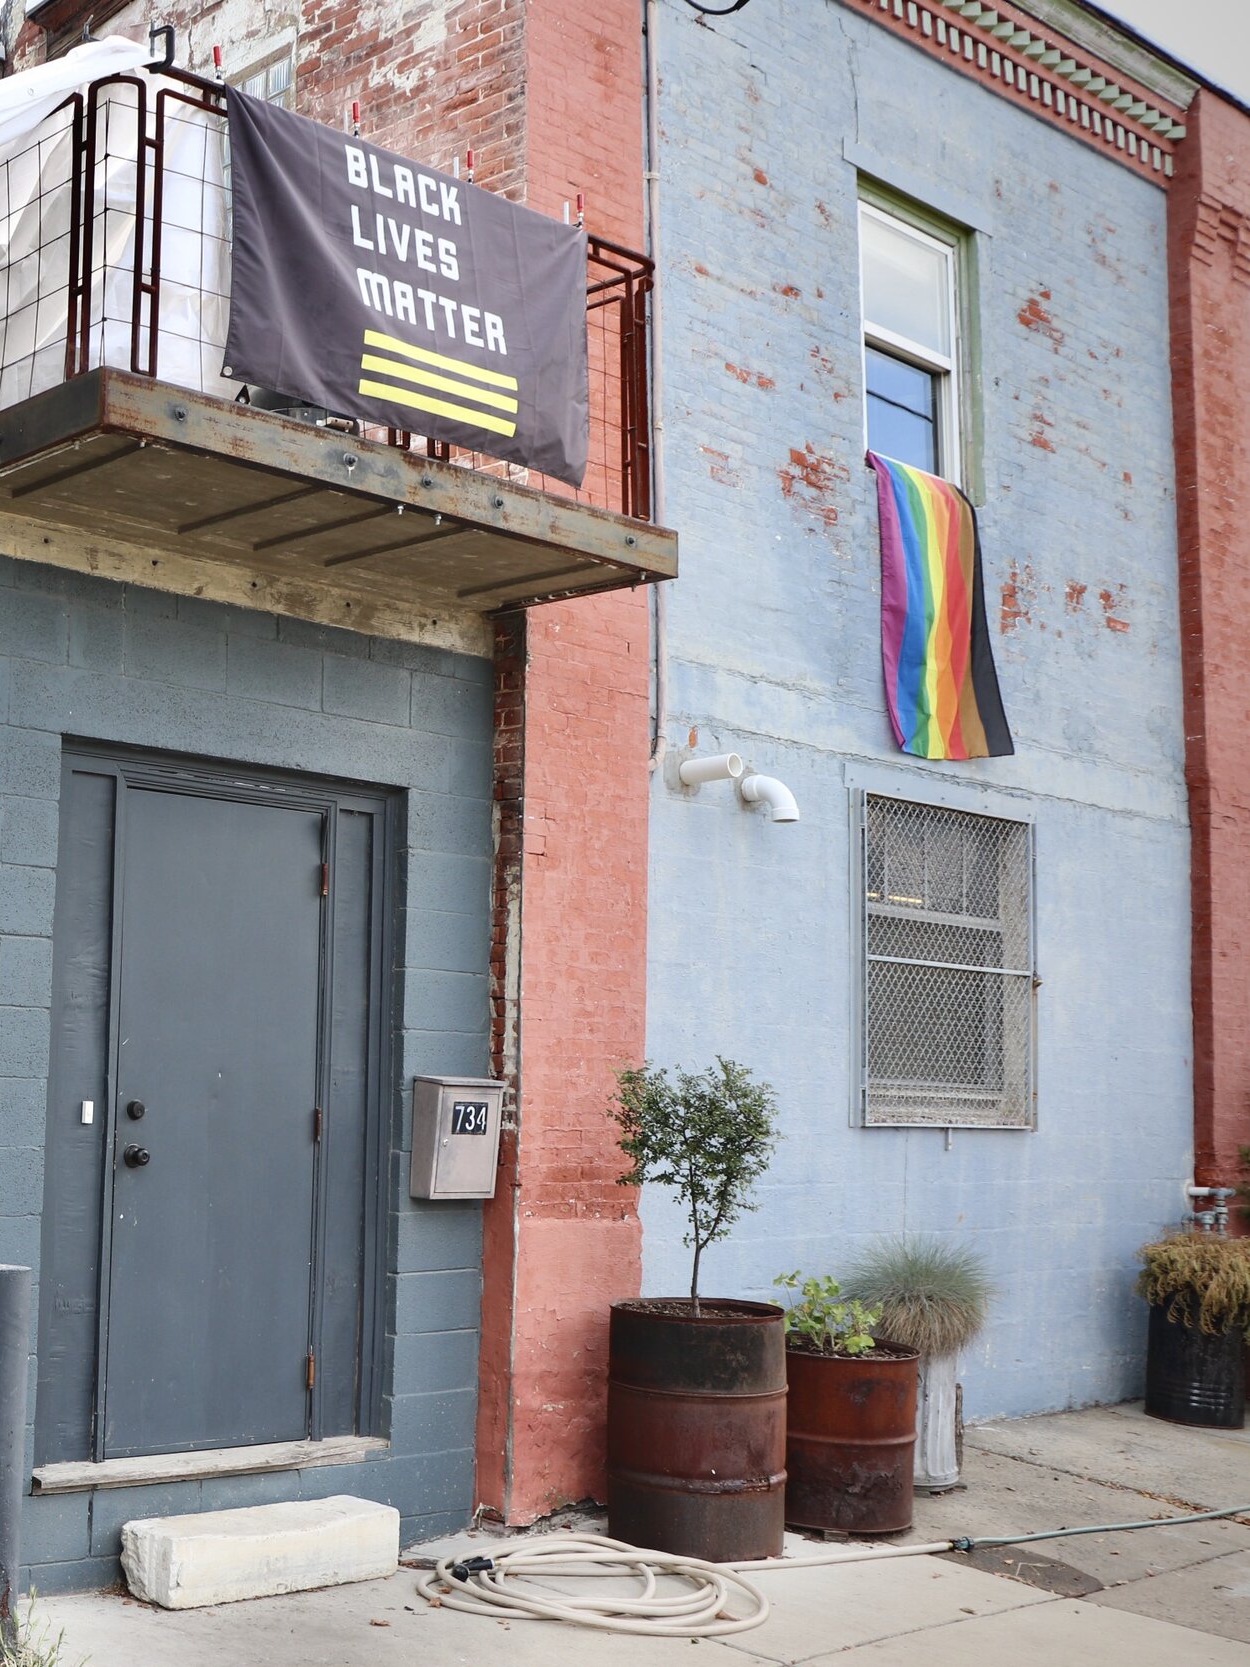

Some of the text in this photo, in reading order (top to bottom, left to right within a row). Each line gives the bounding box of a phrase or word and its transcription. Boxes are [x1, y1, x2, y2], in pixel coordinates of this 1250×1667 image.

[345, 144, 462, 226] BLACK
[351, 205, 460, 281] LIVES
[356, 267, 507, 355] MATTER
[455, 1106, 487, 1134] 734
